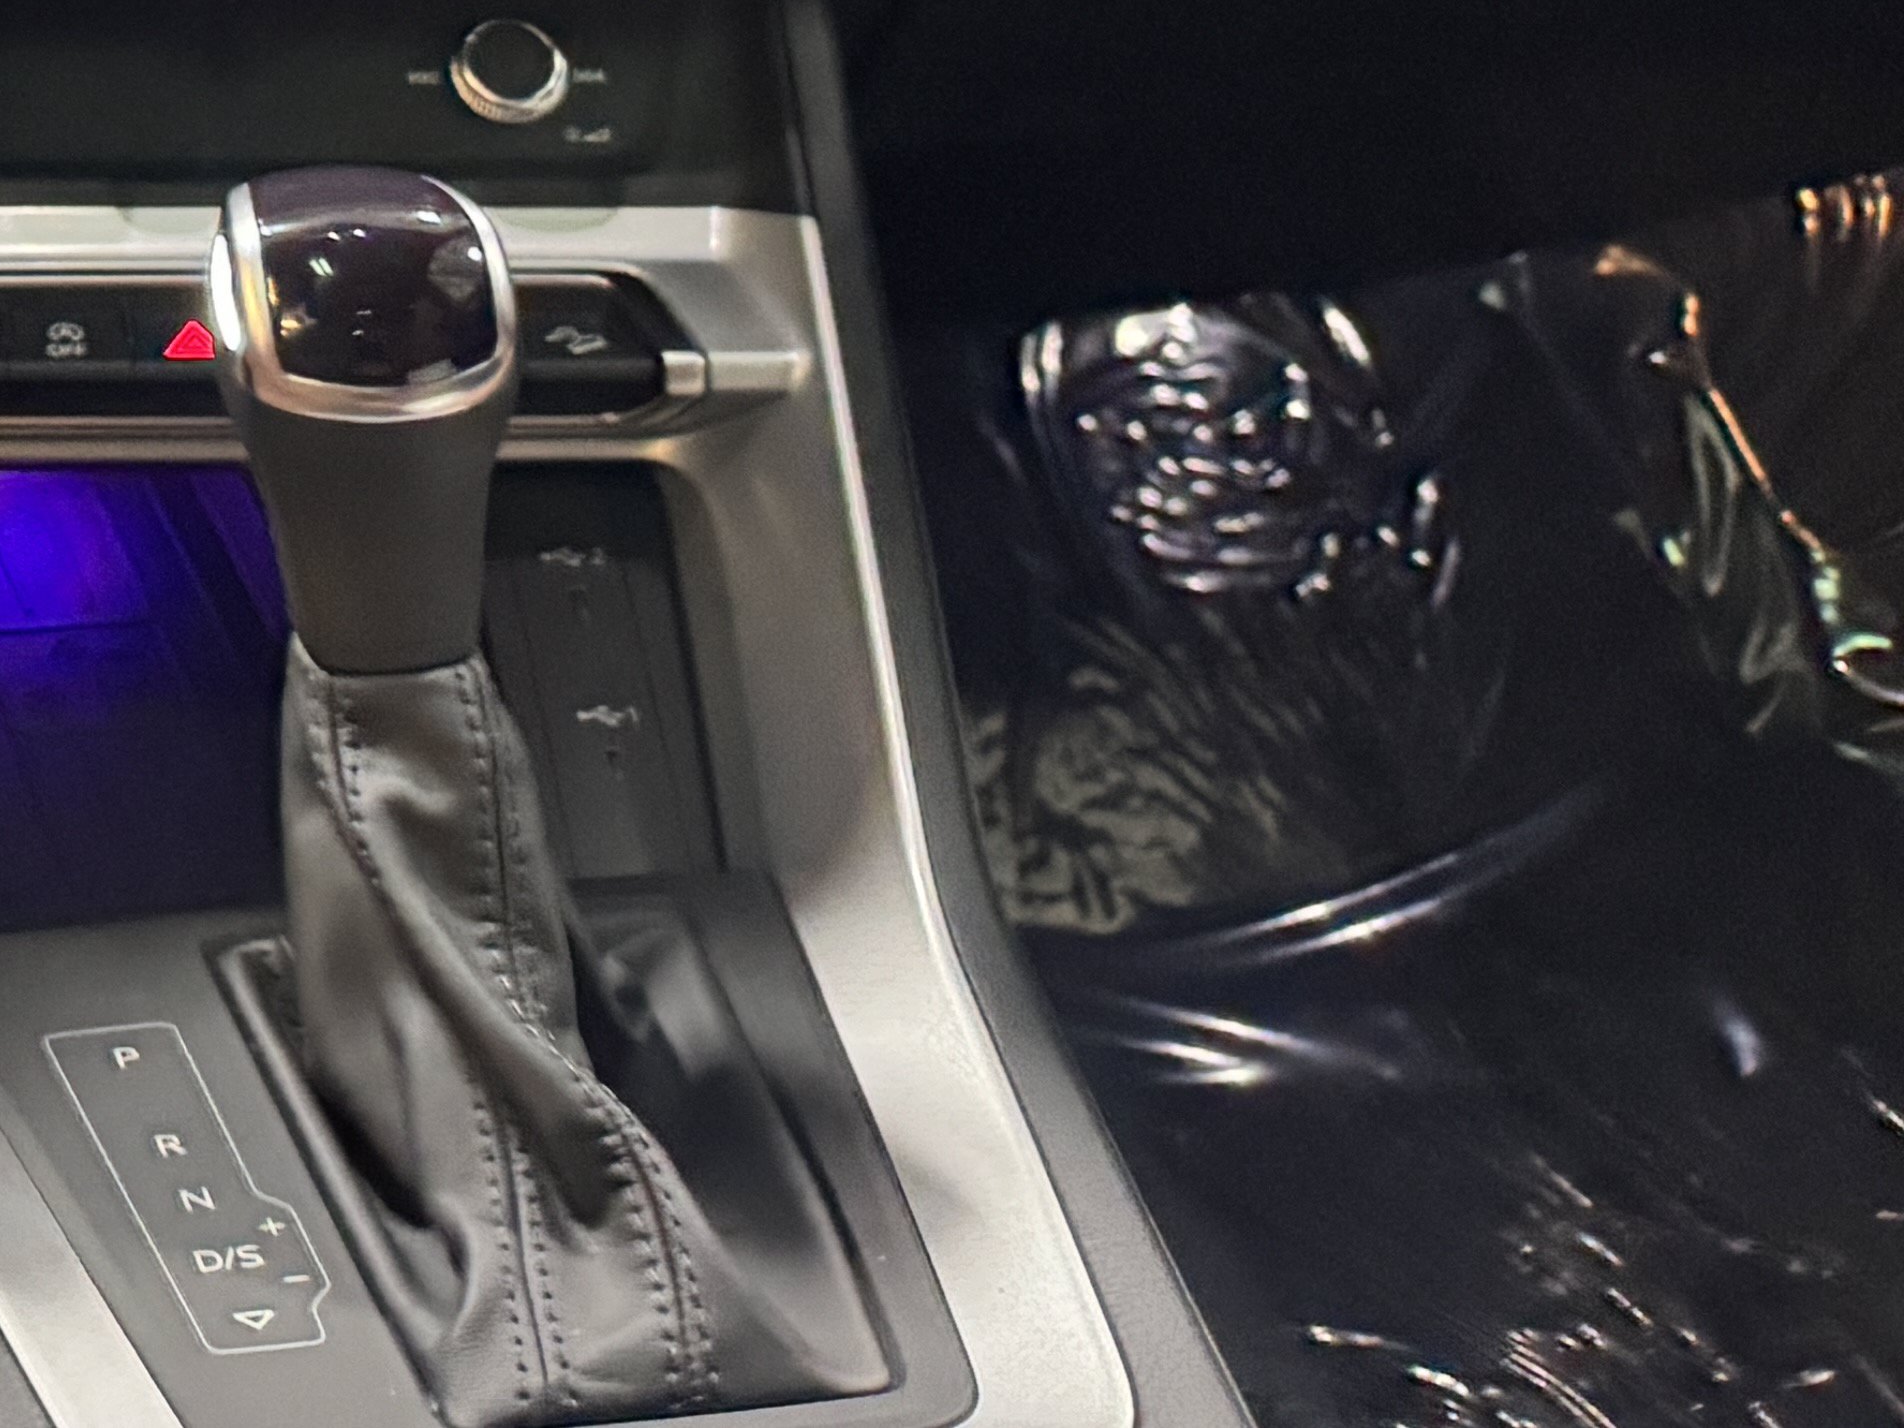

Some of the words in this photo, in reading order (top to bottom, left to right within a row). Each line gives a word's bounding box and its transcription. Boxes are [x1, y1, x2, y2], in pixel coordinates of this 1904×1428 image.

[113, 1046, 141, 1070] P
[153, 1134, 188, 1158] R
[178, 1186, 217, 1213] N
[193, 1244, 266, 1274] D/S
